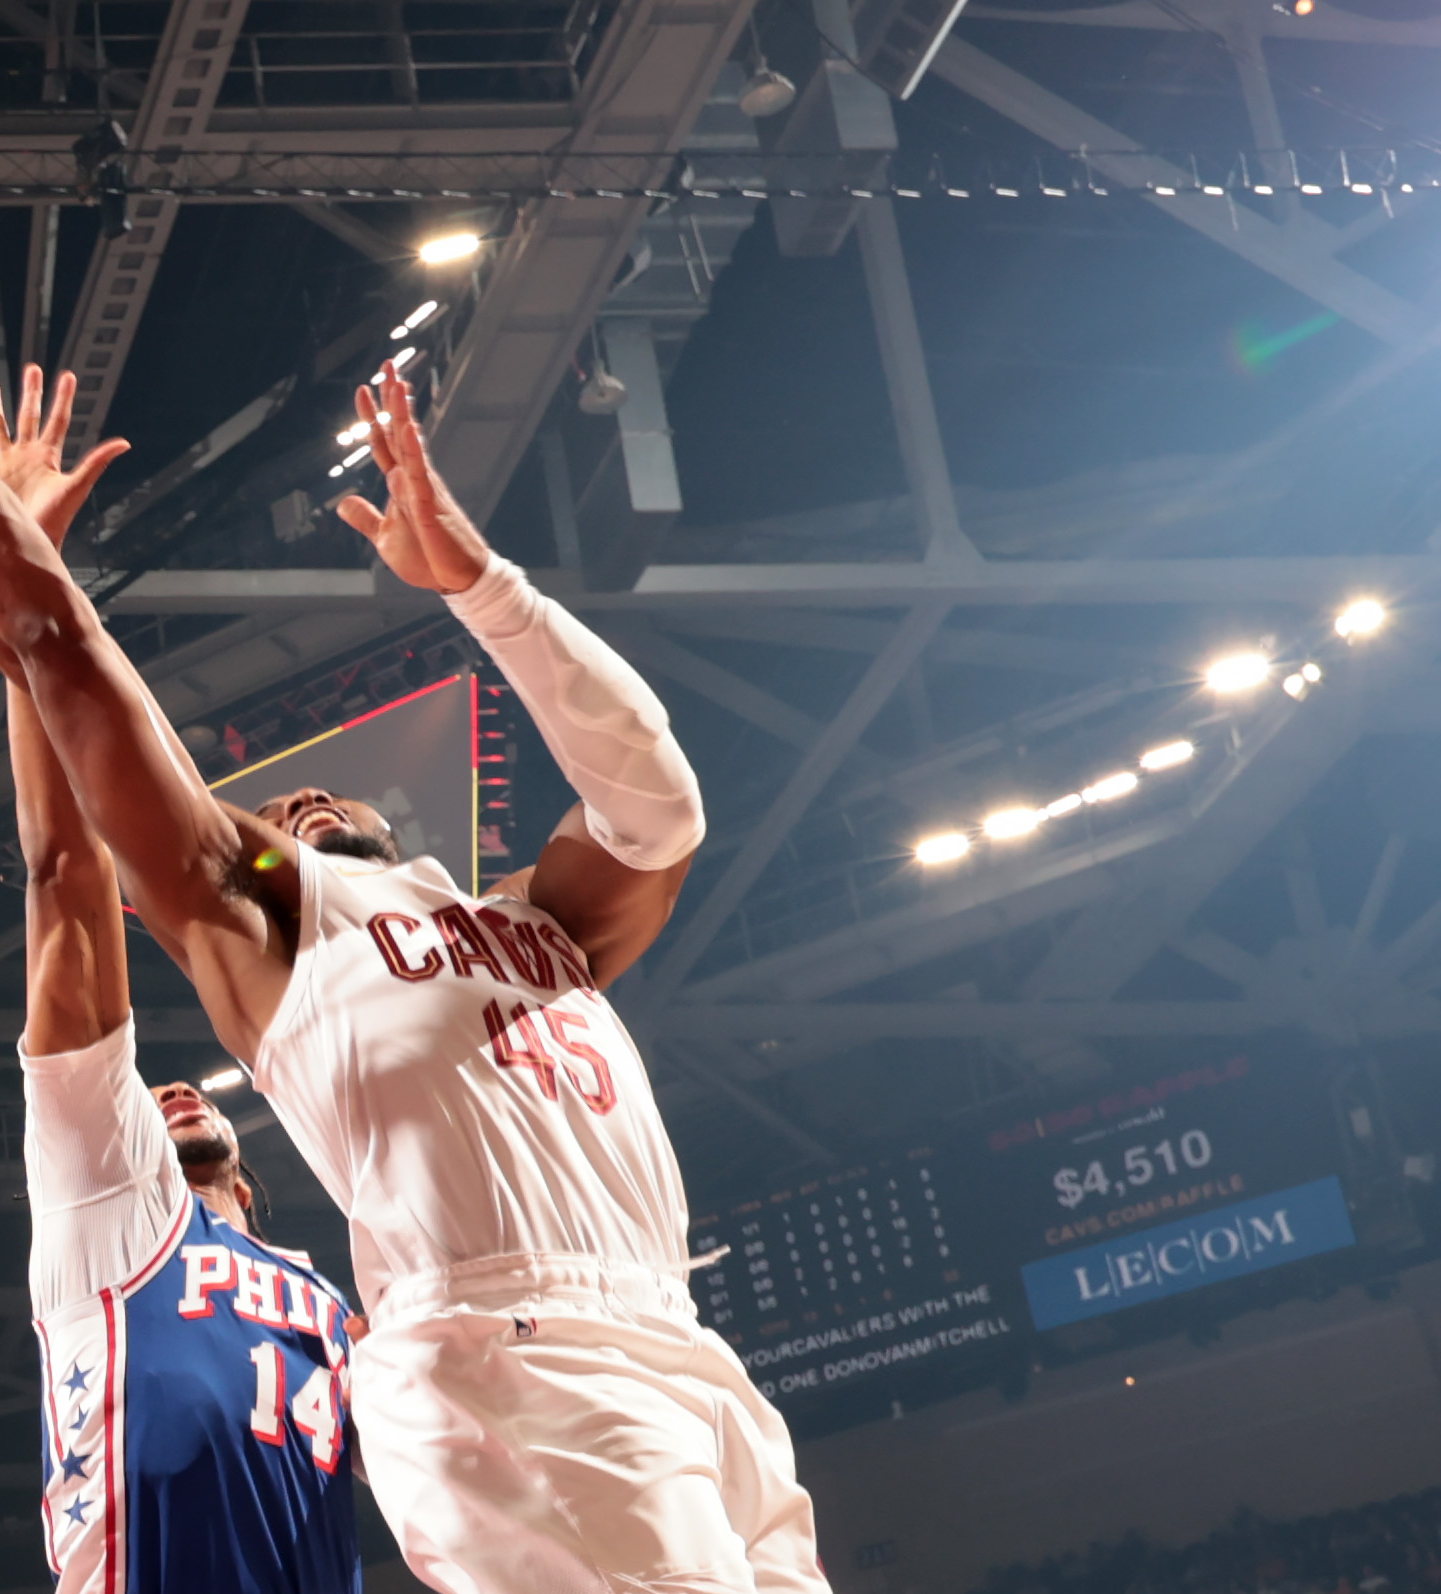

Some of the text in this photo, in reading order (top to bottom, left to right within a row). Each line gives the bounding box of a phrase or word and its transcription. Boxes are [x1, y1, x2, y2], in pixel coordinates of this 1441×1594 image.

[366, 903, 602, 1007] CAVS
[482, 997, 618, 1117] 45
[1053, 1128, 1213, 1210] $4,510
[898, 1299, 950, 1326] WITH
[954, 1283, 991, 1306] THE
[250, 1340, 344, 1475] 14
